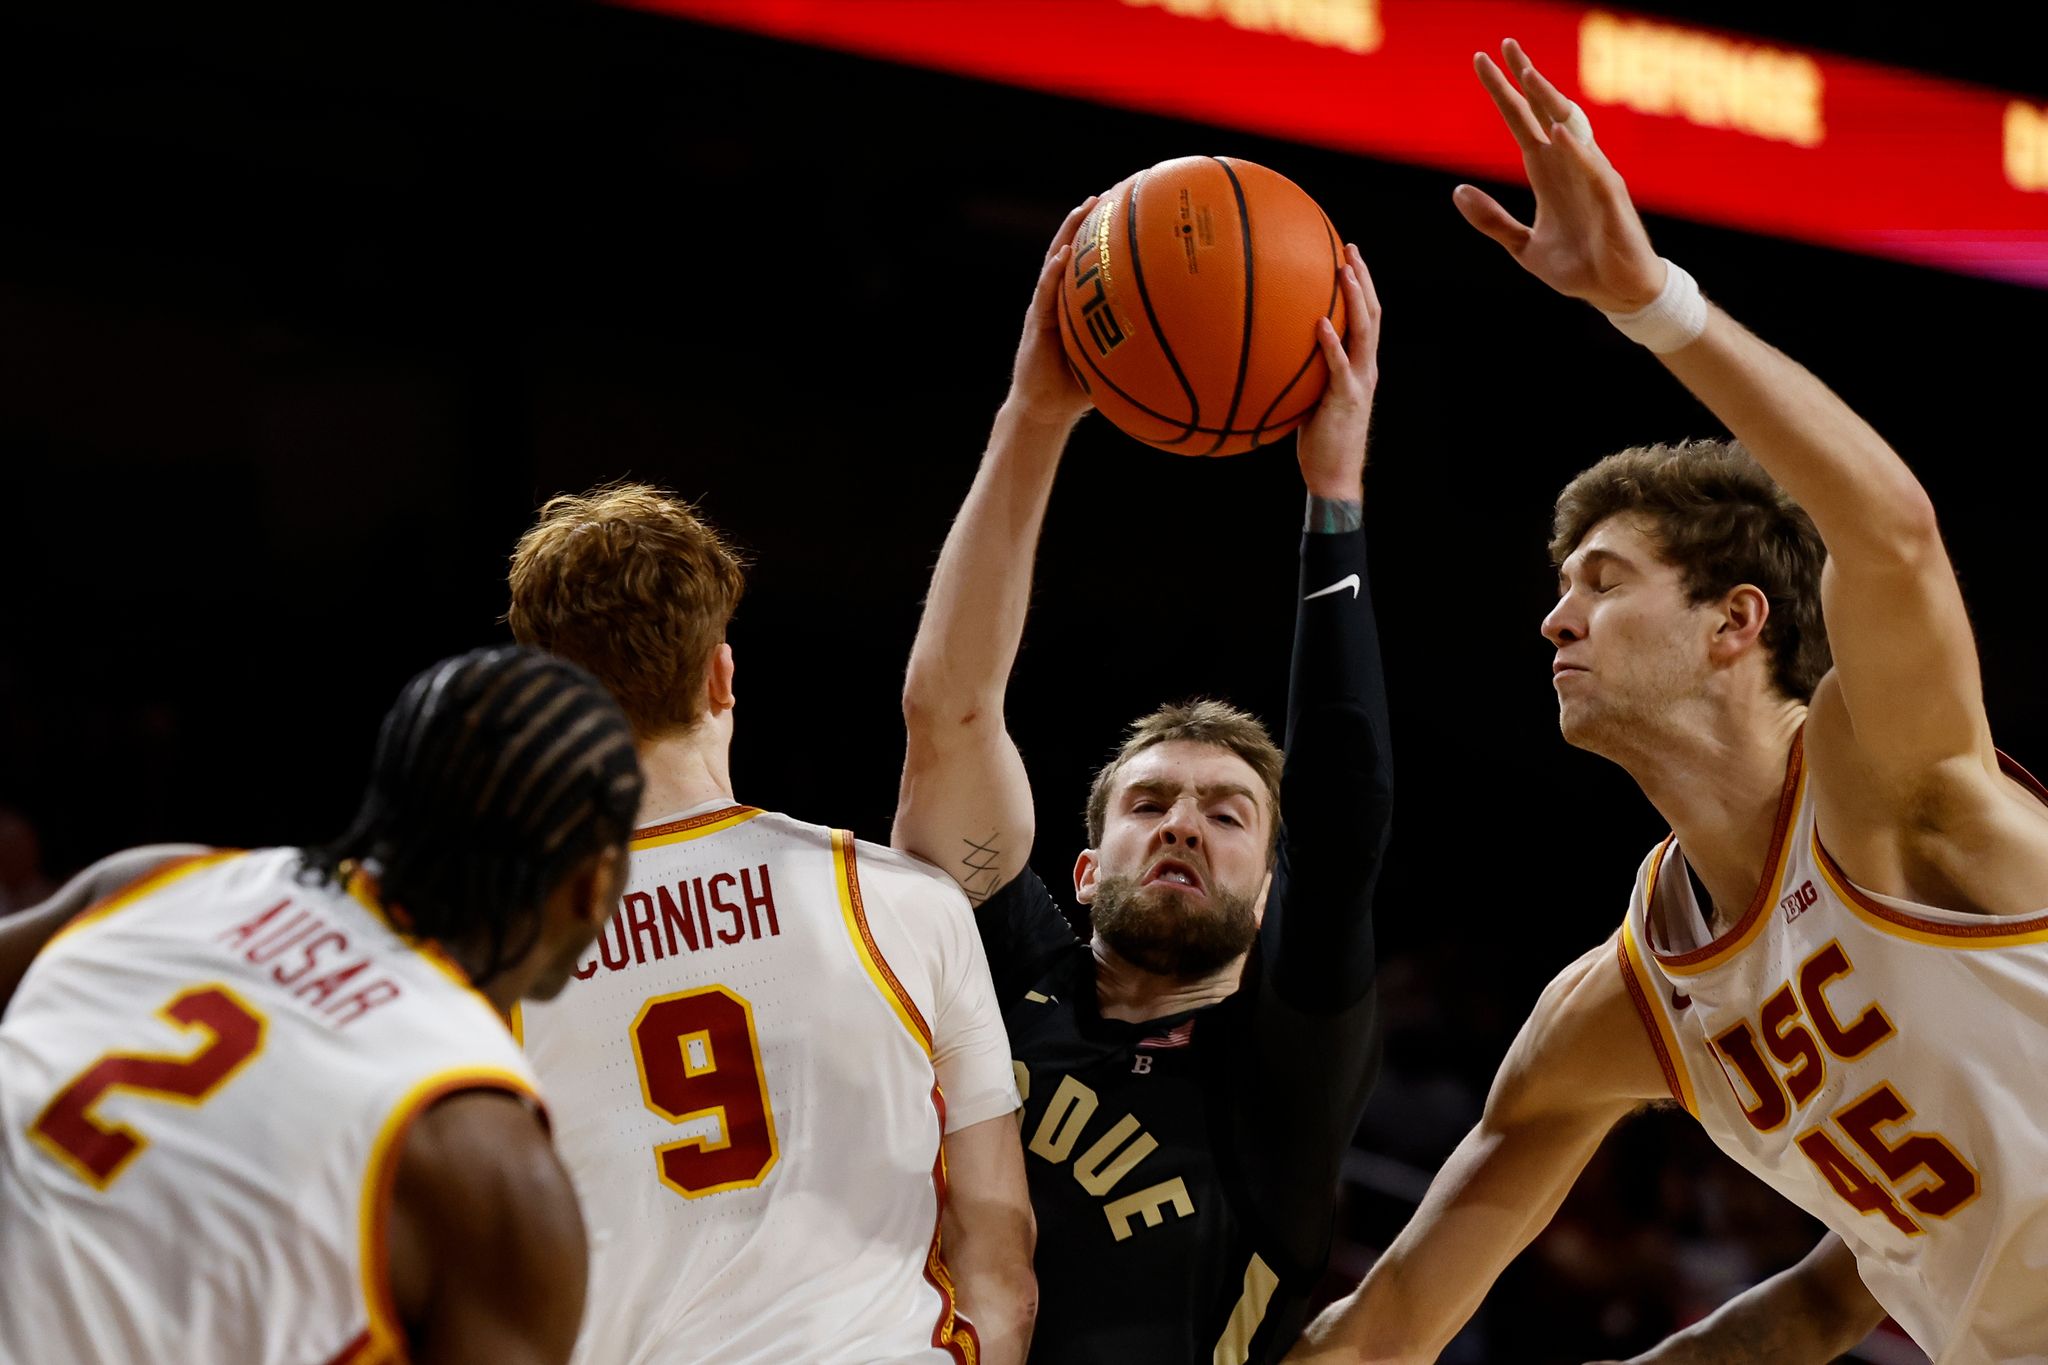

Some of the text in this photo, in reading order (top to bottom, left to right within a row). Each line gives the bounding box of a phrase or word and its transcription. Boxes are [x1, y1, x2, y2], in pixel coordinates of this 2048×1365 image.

[218, 899, 402, 1030] AUSAR
[1705, 938, 1897, 1133] USC
[26, 982, 269, 1191] 2
[629, 984, 779, 1199] 9
[1795, 1080, 1981, 1236] 45
